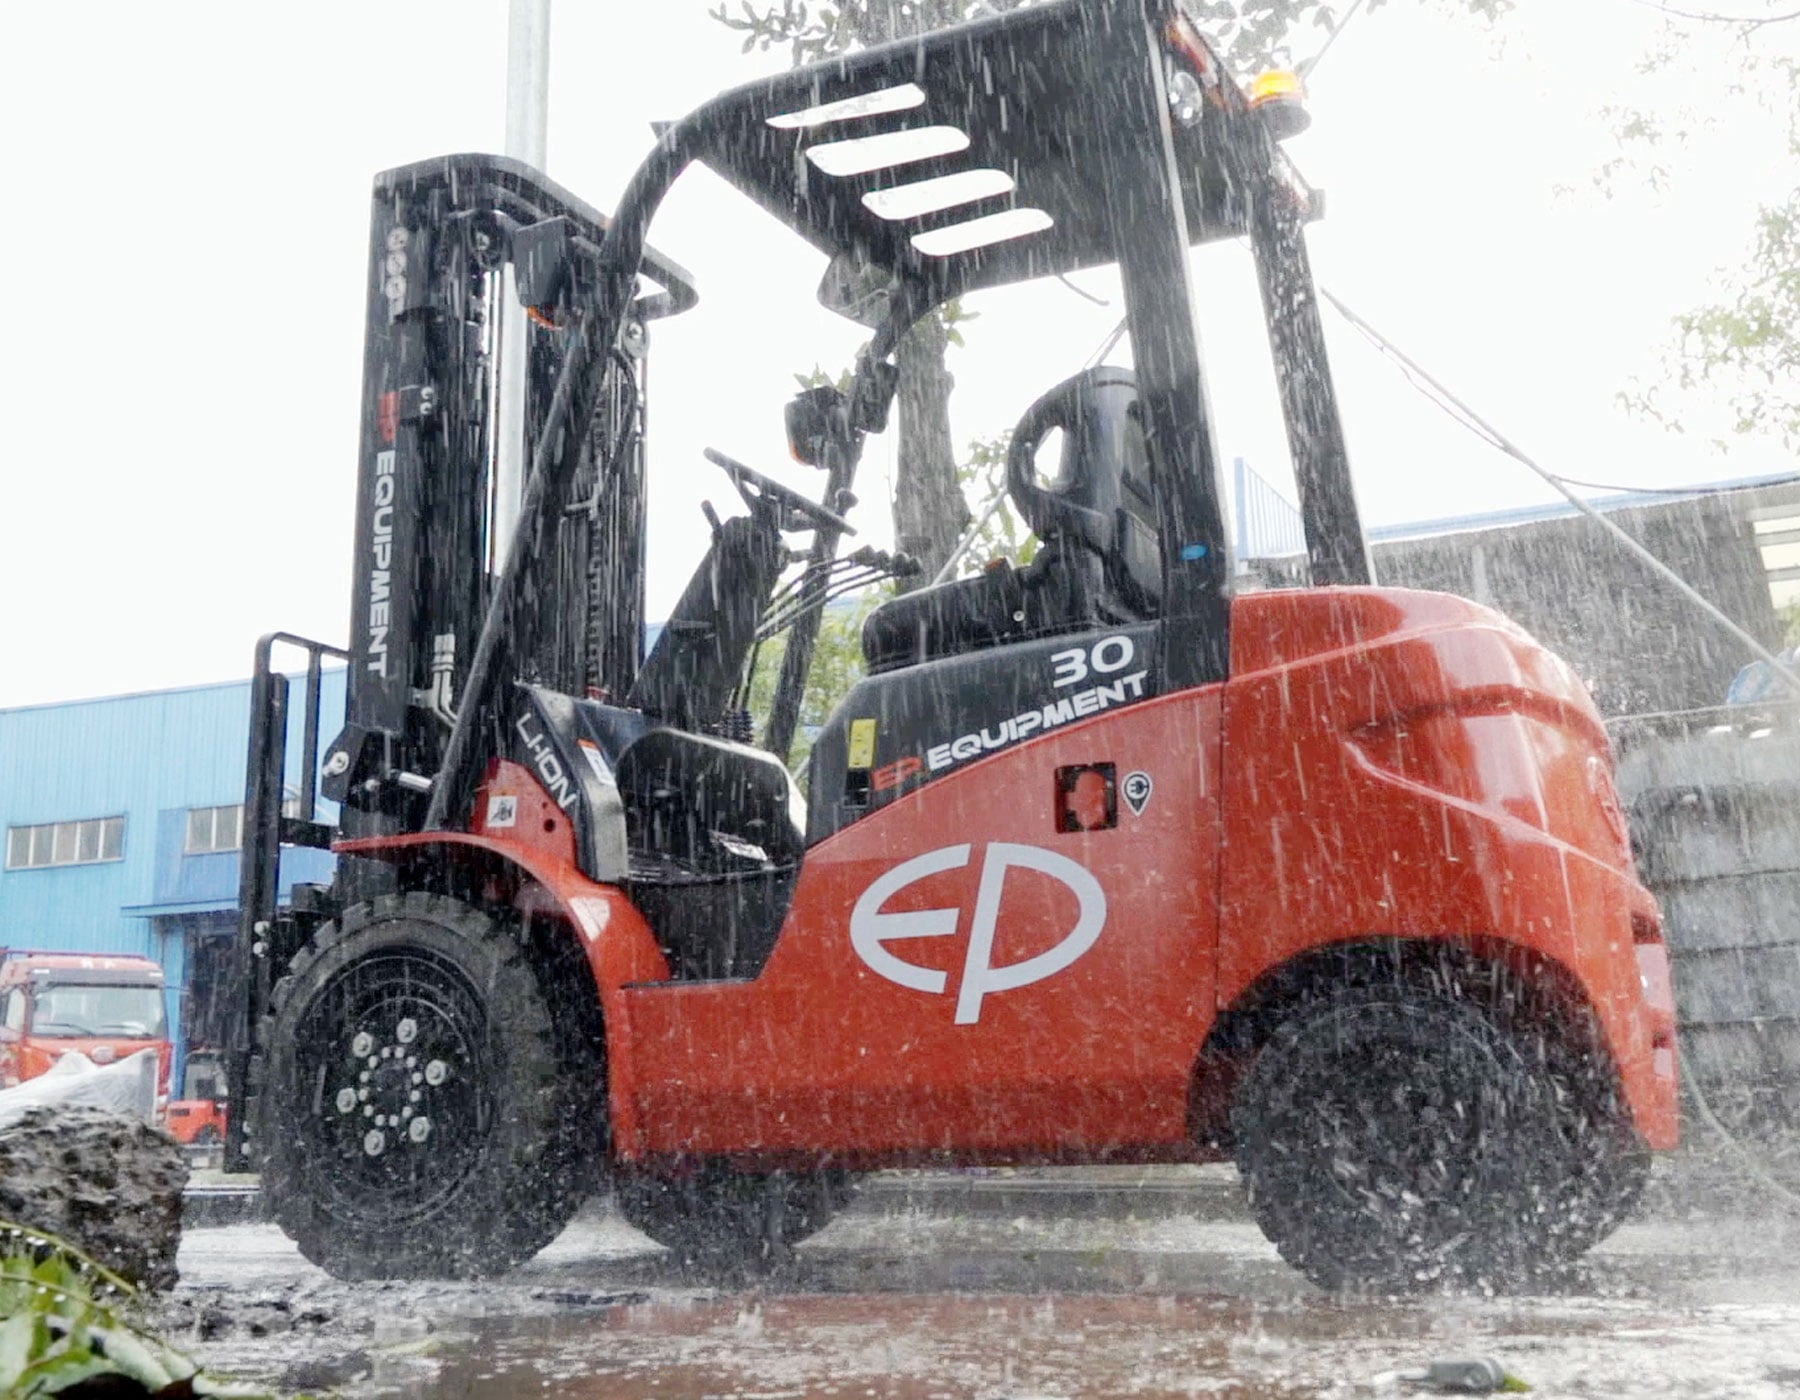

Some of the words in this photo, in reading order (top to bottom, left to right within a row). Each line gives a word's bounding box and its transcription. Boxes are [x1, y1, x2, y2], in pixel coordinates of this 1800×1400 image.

[367, 449, 396, 679] EQUIPMENT
[926, 669, 1149, 770] EQUIPMENT
[1050, 634, 1134, 689] 30
[849, 841, 1107, 1025] EP
